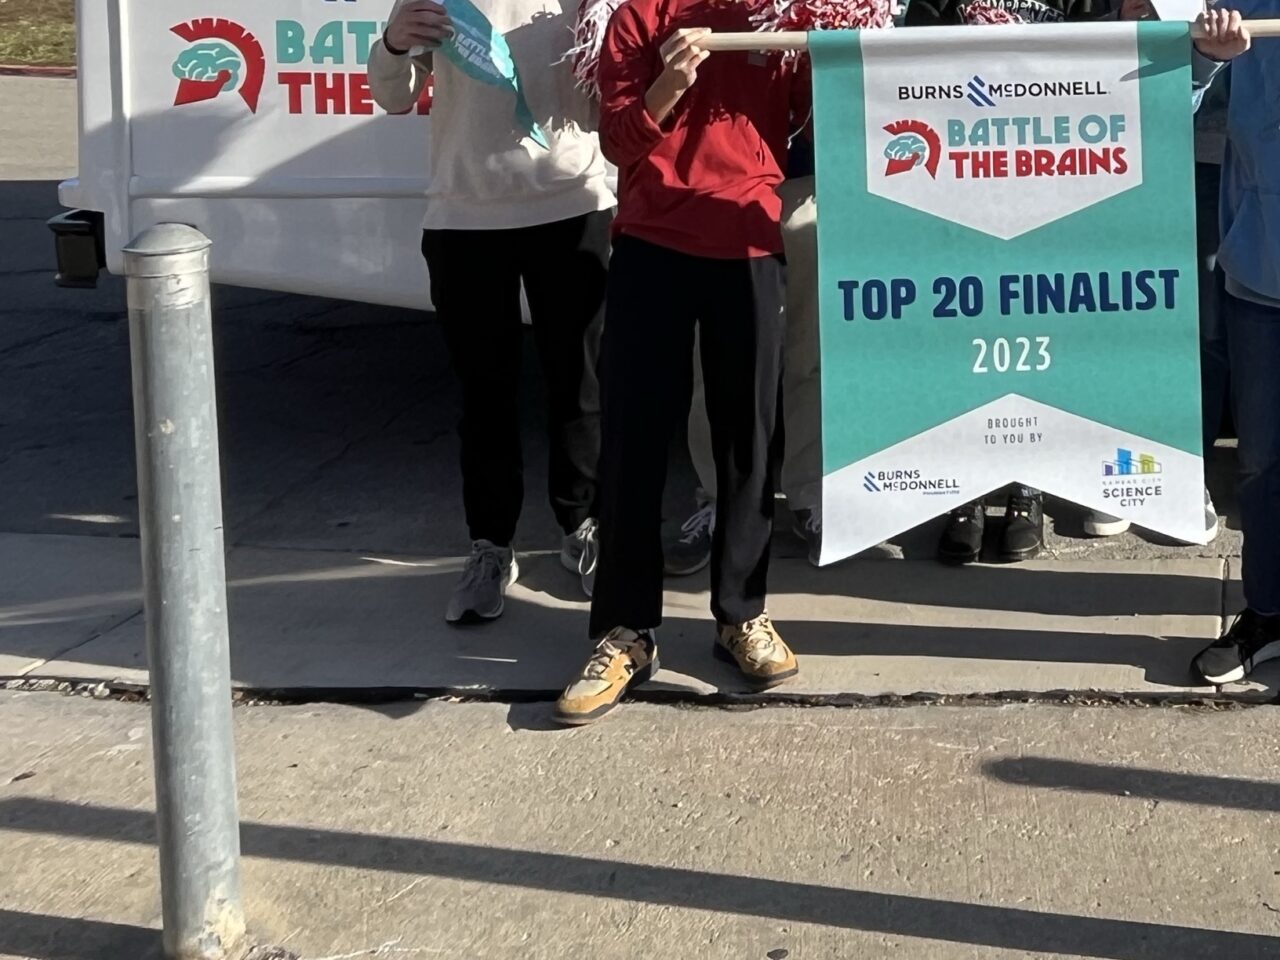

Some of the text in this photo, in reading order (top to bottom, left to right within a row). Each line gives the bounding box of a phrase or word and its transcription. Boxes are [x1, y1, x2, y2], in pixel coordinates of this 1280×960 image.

[278, 72, 373, 114] THE
[898, 85, 963, 100] BURNS
[947, 114, 1126, 147] BATTLE OF
[949, 146, 1128, 179] THE BRAINS
[838, 269, 1179, 321] TOP 20 FINALIST
[972, 336, 1051, 373] 2023
[987, 416, 1038, 429] BROUGHT
[984, 432, 1043, 445] TO YOU BY
[878, 469, 920, 481] BURNS
[1103, 486, 1162, 499] SCIENCE
[1120, 498, 1145, 507] CITY
